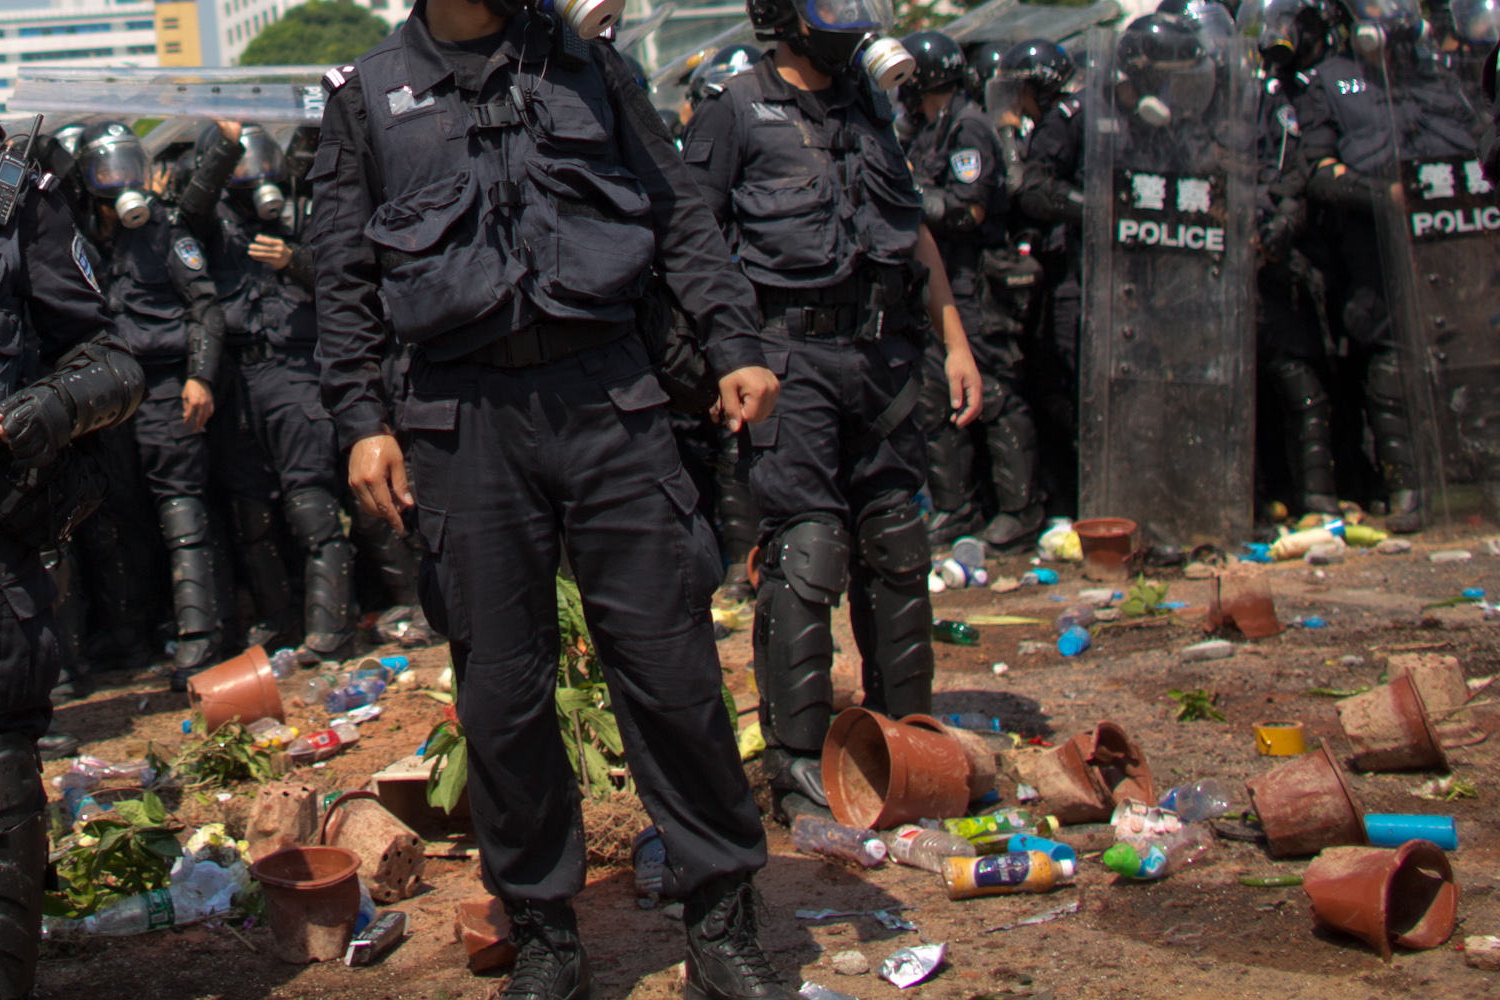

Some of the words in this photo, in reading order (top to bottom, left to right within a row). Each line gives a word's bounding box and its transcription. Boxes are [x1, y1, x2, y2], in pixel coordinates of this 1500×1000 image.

[1131, 172, 1212, 214] 警察
[1118, 218, 1225, 252] POLICE
[1411, 205, 1500, 237] POLIC
